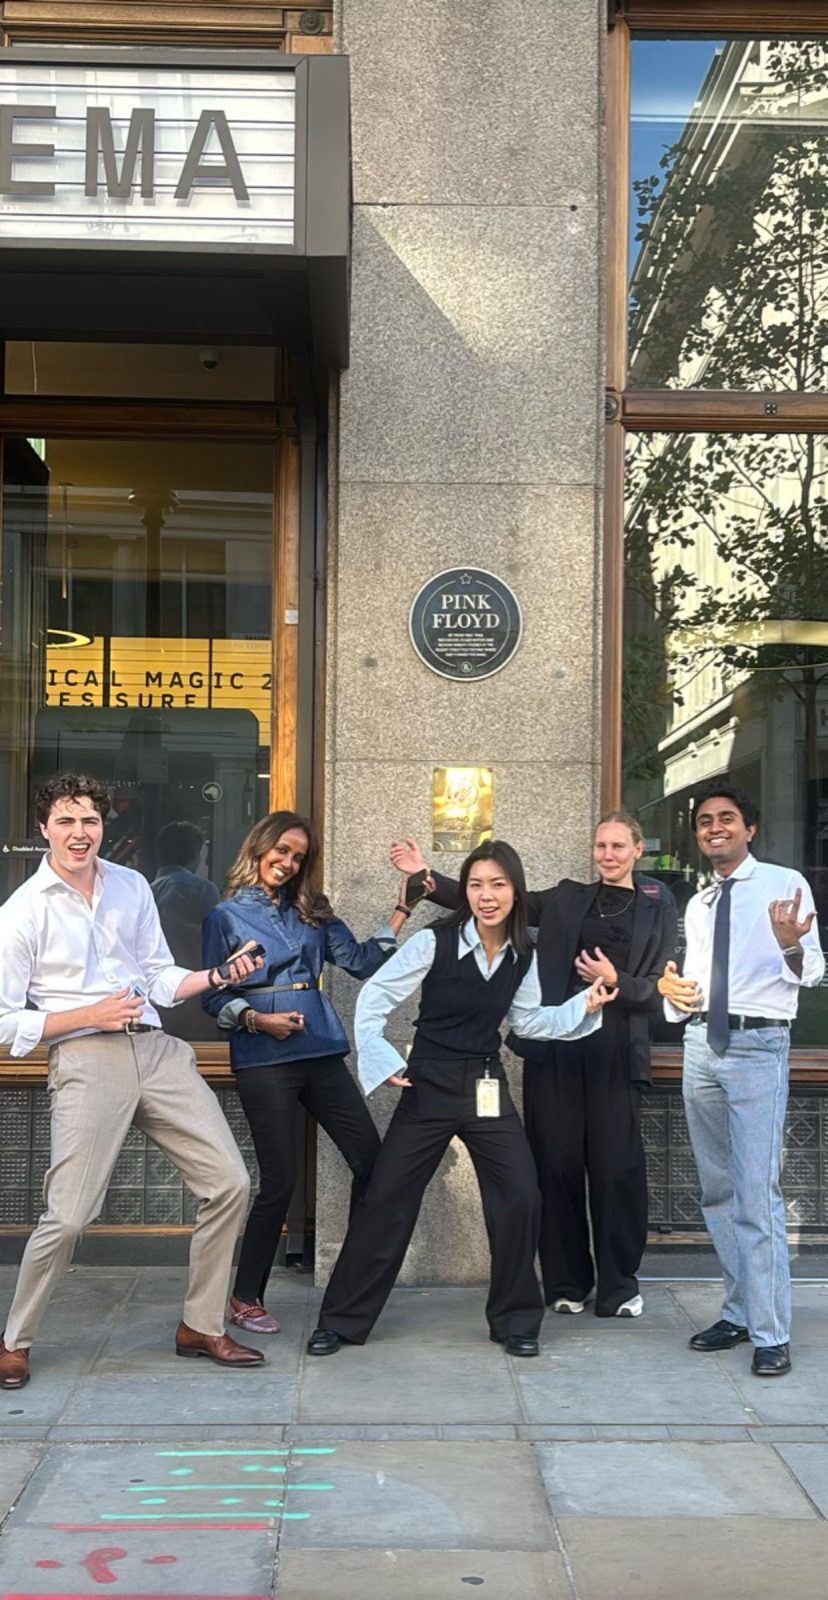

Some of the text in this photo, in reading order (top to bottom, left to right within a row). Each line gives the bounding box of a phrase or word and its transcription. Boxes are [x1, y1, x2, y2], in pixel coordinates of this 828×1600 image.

[0, 105, 250, 201] EMA
[441, 594, 492, 610] PINK
[432, 613, 500, 629] FLOYD
[48, 669, 122, 687] ICAL
[145, 671, 244, 690] MAGIC
